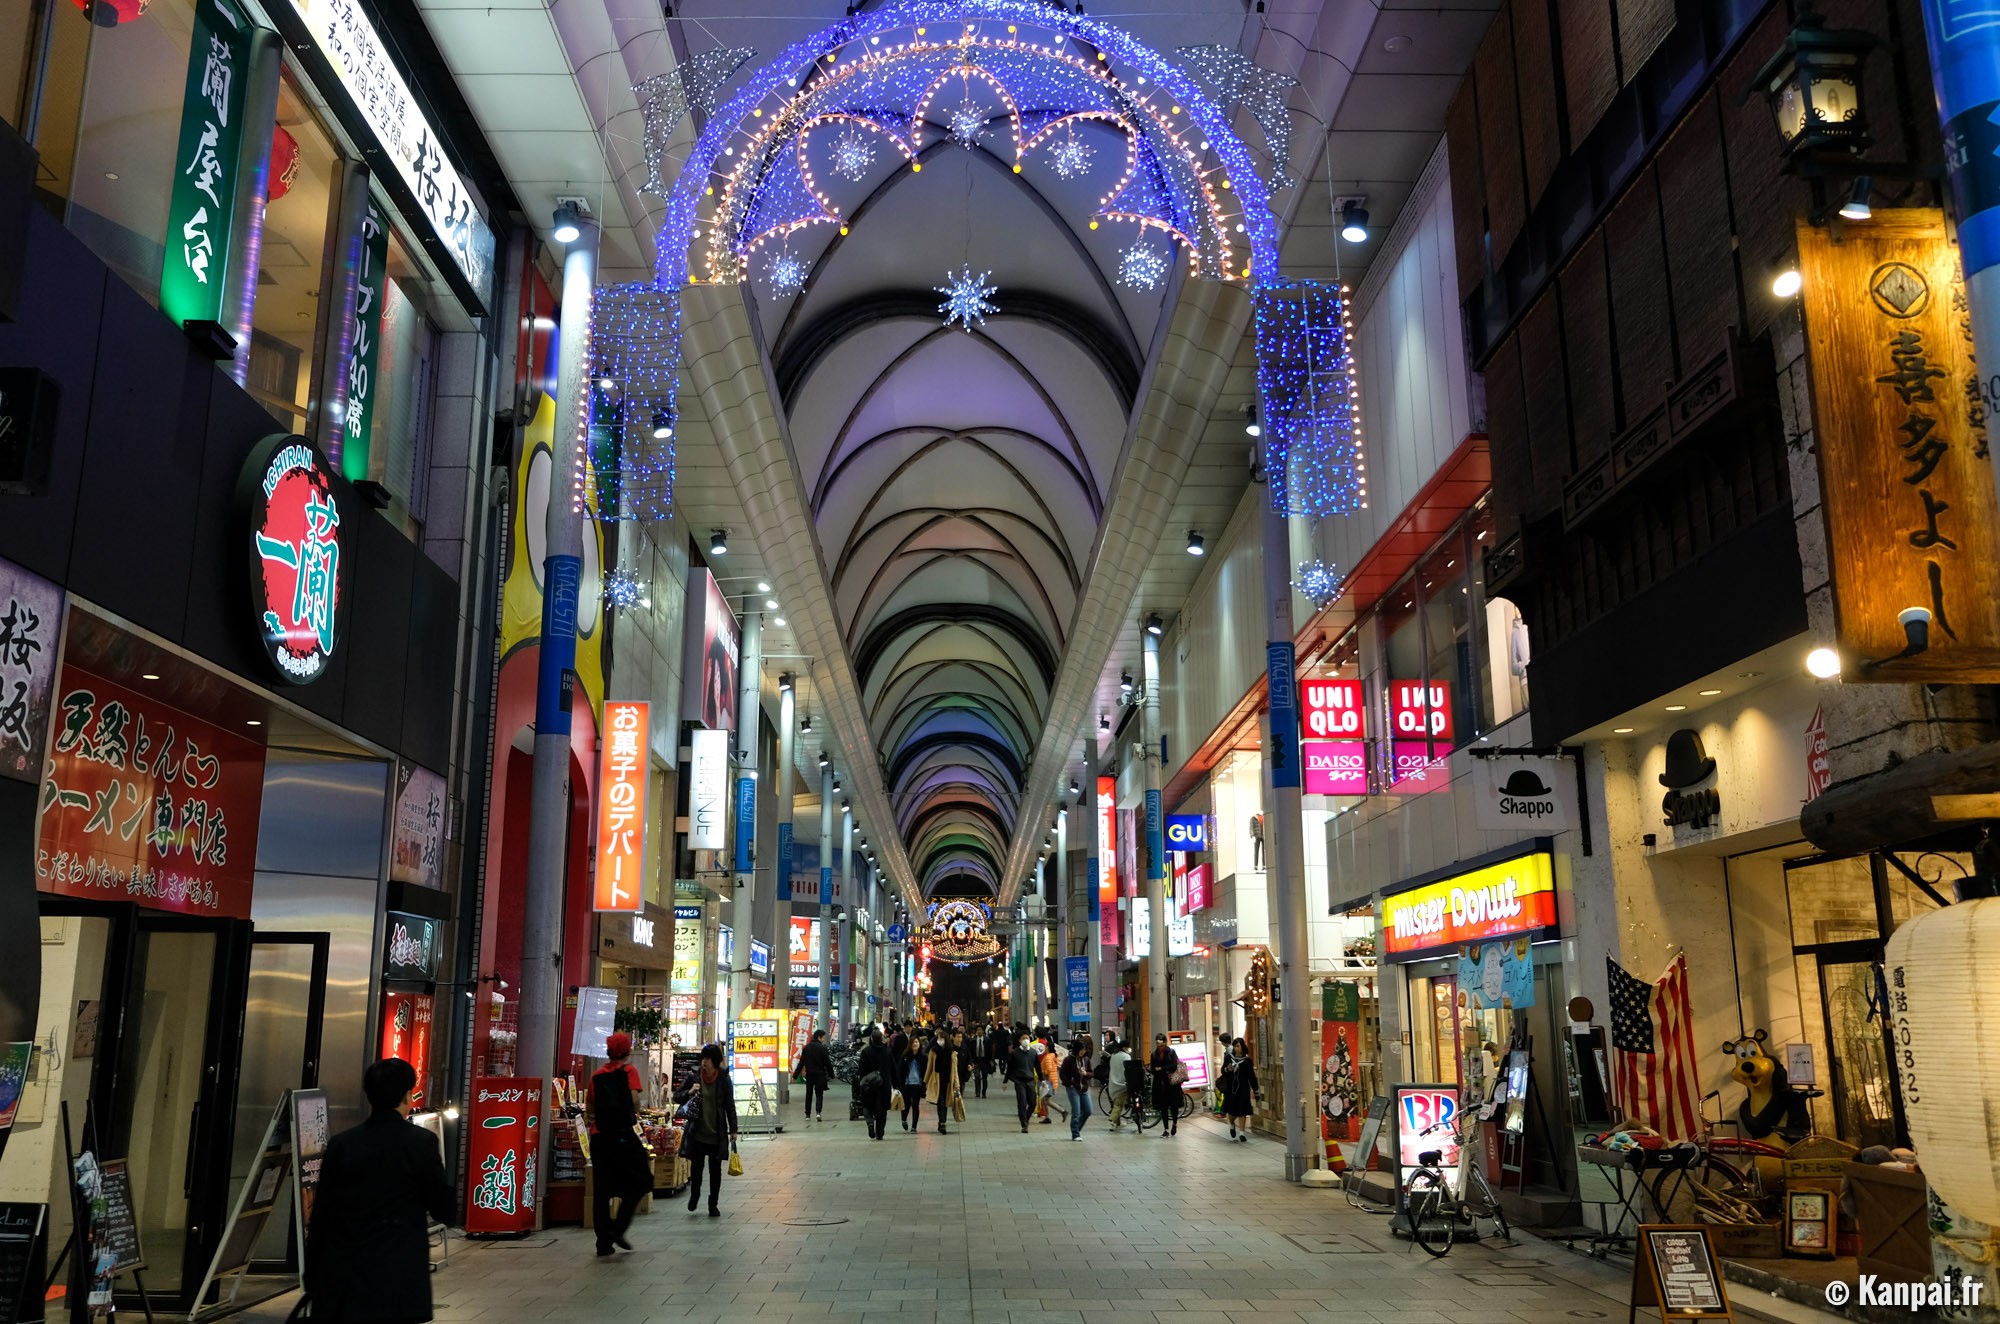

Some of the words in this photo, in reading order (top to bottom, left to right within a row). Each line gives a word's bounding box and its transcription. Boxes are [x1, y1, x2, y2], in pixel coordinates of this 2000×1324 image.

[263, 445, 313, 499] ICHIRAN
[1876, 330, 1957, 641] 喜多よし
[256, 490, 340, 655] 一蘭
[1308, 686, 1353, 708] UNI
[56, 689, 221, 790] 天然とんこつ
[1309, 711, 1358, 736] QLO
[1309, 755, 1363, 767] DAISO
[607, 705, 639, 908] お菓子のデパート
[1499, 797, 1554, 819] Shappo
[1662, 787, 1720, 829] Shappo
[1168, 824, 1202, 842] GU
[1451, 876, 1522, 927] Donut
[478, 1089, 523, 1103] ラーメン
[1402, 1094, 1454, 1131] BR
[474, 1116, 517, 1215] 一蘭
